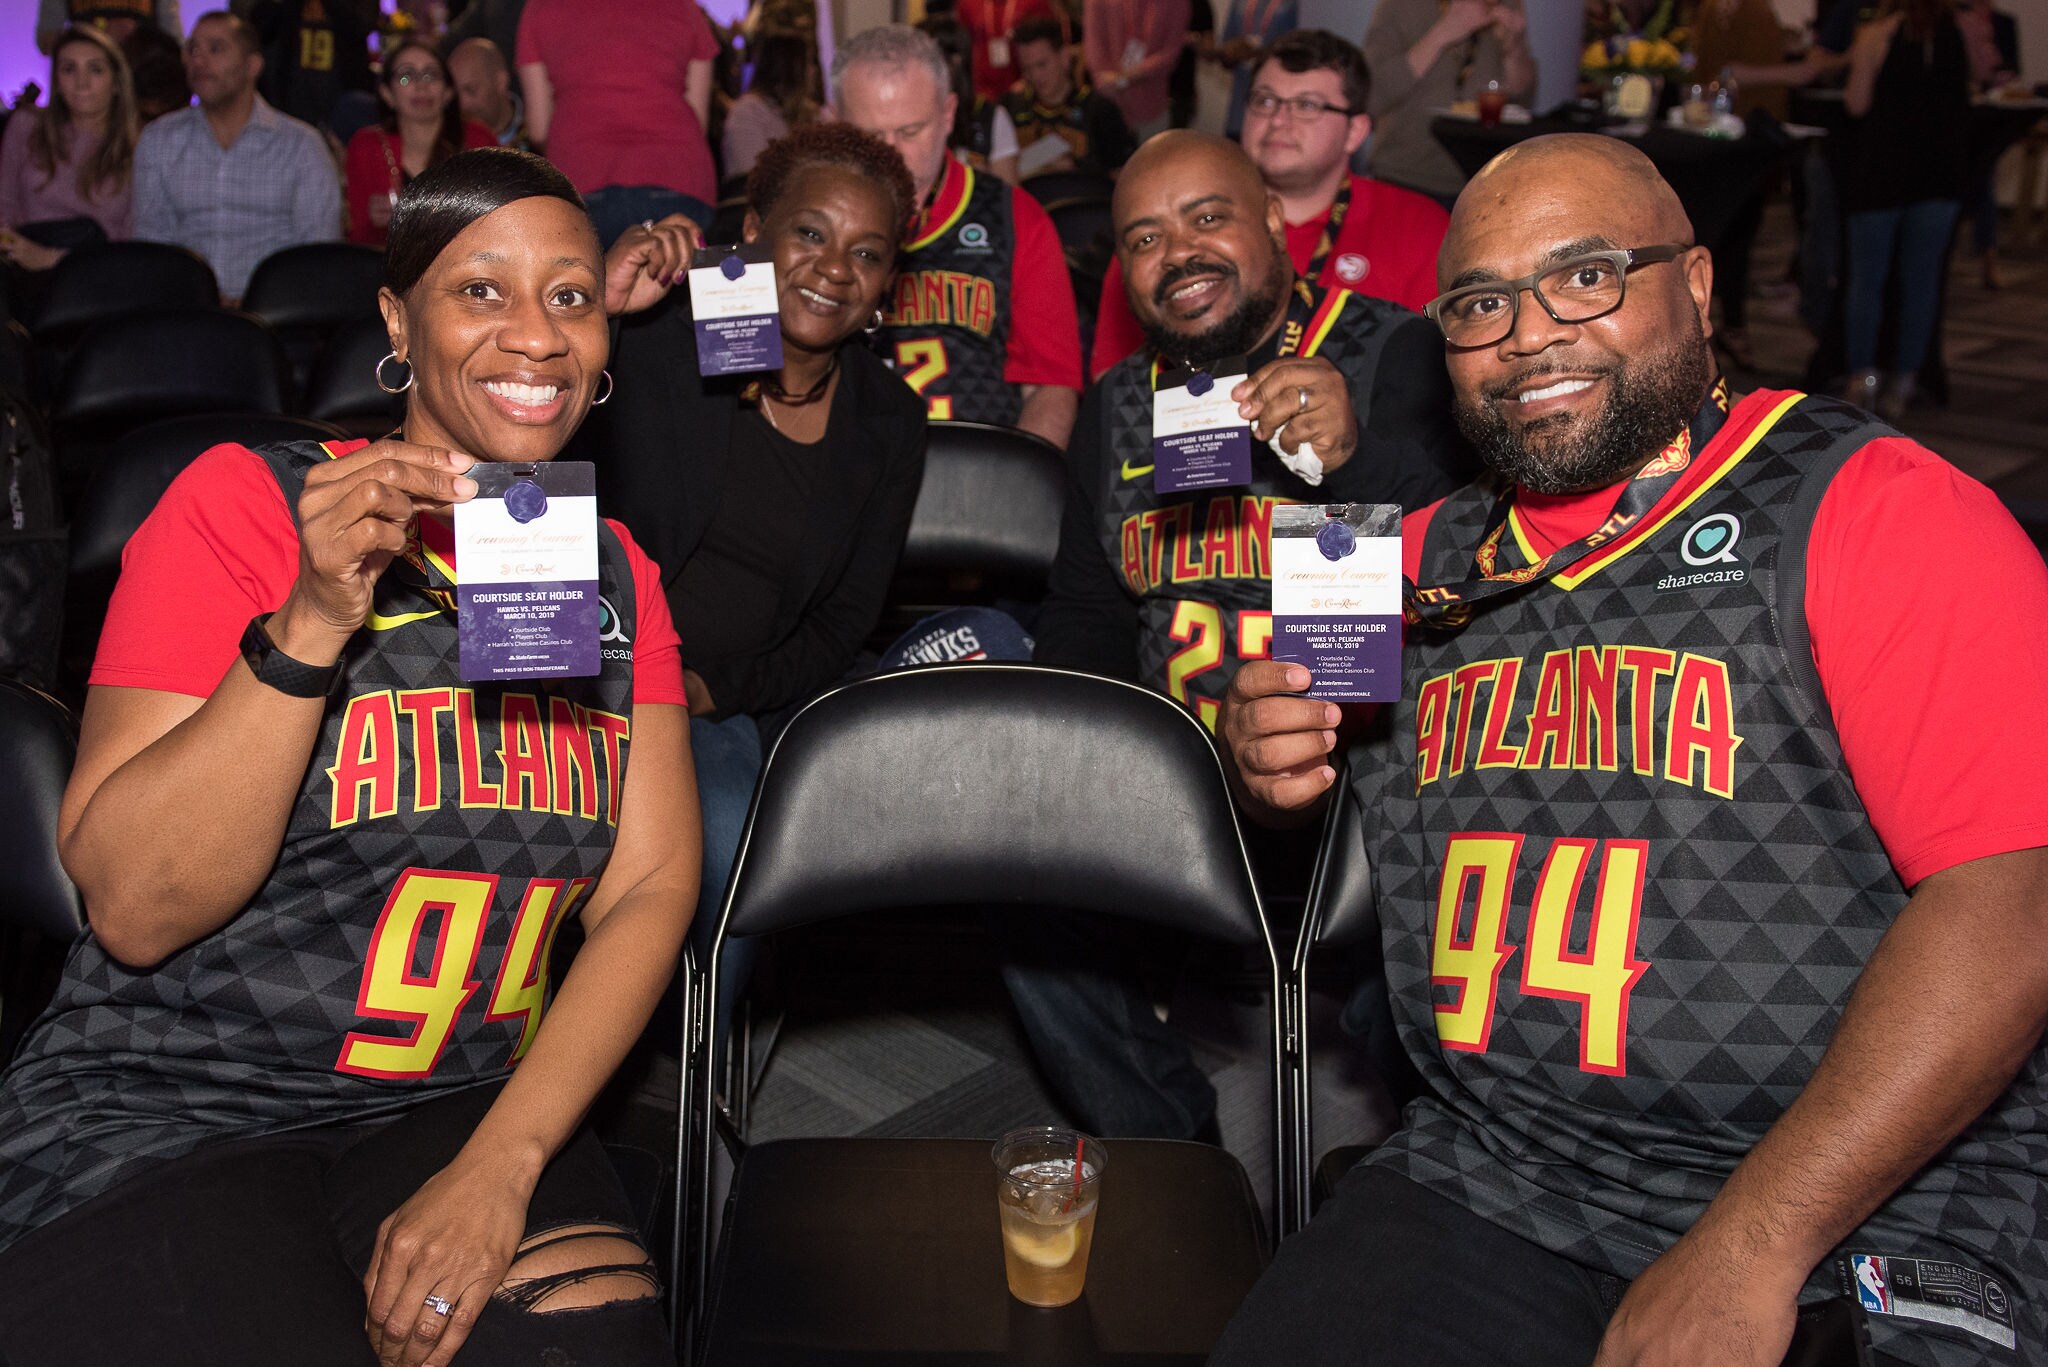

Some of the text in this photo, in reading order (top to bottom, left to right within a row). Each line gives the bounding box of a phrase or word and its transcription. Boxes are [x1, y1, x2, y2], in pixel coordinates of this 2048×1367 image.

[884, 270, 996, 337] ANTA
[1121, 495, 1298, 596] ATLAN
[1657, 569, 1744, 590] sharecare
[473, 590, 584, 603] COURTSIDE SEAT HOLDER
[532, 604, 561, 612] PELICANS
[1285, 624, 1387, 633] COURTSIDE SEAT HOLDER
[600, 648, 634, 662] recar
[1415, 645, 1745, 800] ATLANTA
[325, 686, 629, 830] ATLANT
[1431, 831, 1652, 1078] 94
[335, 866, 594, 1080] 94
[1896, 1274, 1912, 1287] 56
[1863, 1301, 1879, 1311] NBA
